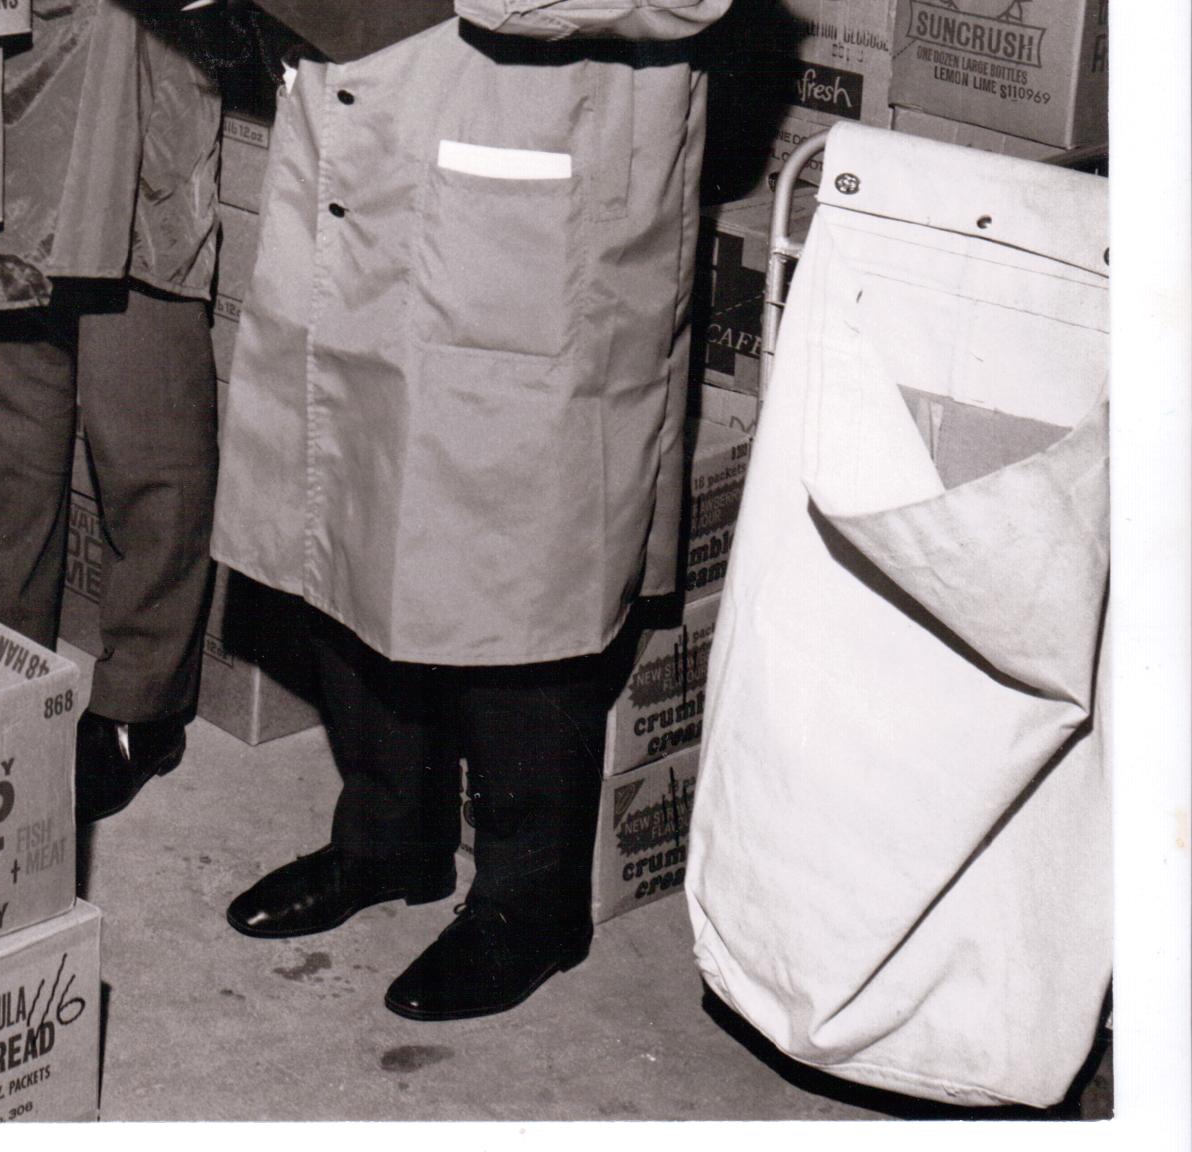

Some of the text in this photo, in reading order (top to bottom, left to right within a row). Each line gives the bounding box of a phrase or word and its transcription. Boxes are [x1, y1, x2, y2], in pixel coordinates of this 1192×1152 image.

[917, 10, 1034, 61] SUNCRUSH
[934, 66, 996, 95] LEMON LIME
[44, 691, 73, 720] 868
[16, 819, 52, 853] FISH
[24, 838, 67, 876] MEAT
[8, 1064, 52, 1096] PACKETS
[8, 1100, 34, 1121] 306
